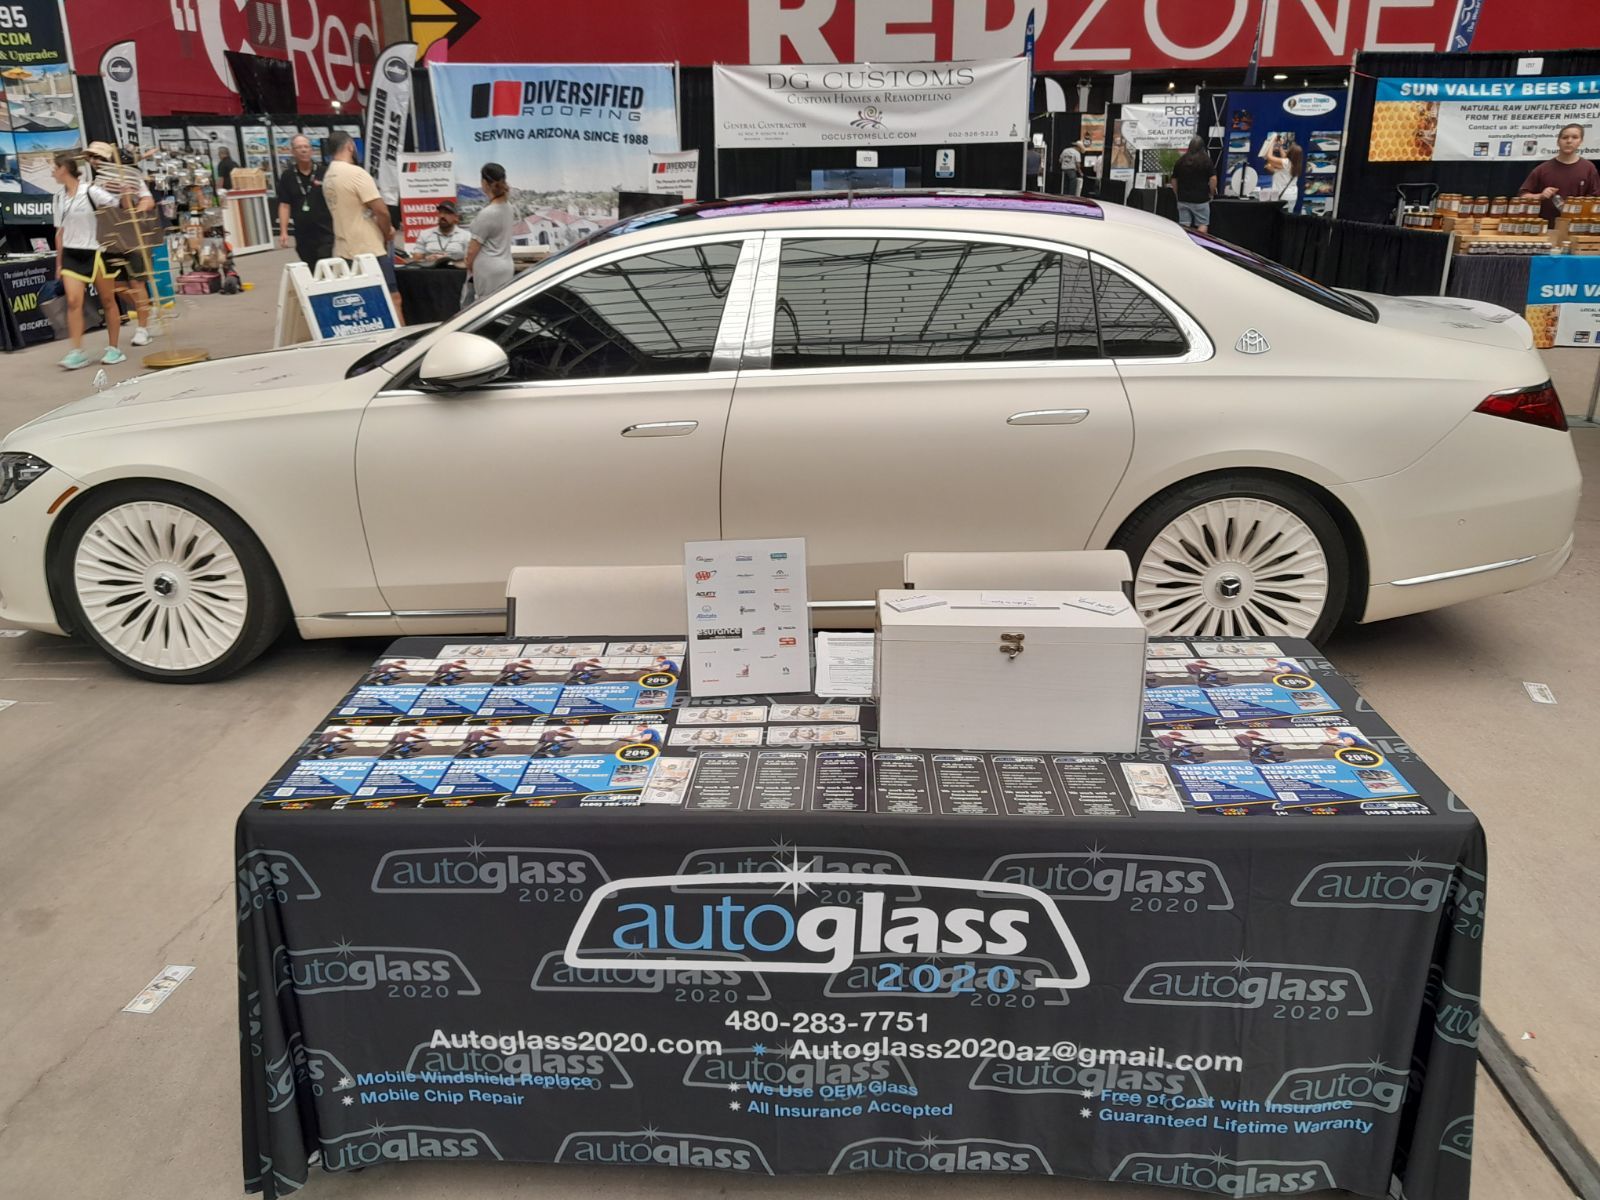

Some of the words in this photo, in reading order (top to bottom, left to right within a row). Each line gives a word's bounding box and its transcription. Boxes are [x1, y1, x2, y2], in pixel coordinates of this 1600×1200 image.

[9, 49, 58, 62] Upgrades
[766, 72, 810, 90] DG
[822, 67, 975, 90] CUSTOMS
[523, 80, 644, 110] DIVERSIFIED
[1400, 82, 1439, 96] SUN
[1445, 83, 1516, 96] VALLEY
[1521, 82, 1572, 96] BEES
[787, 93, 832, 105] CUSTOM
[833, 93, 874, 104] HOMES
[875, 95, 881, 103] &
[884, 91, 952, 103] REMODELING
[521, 105, 642, 122] ROOFING
[1524, 103, 1577, 111] UNFILTERED
[125, 109, 139, 147] STE
[369, 87, 388, 180] BUILDINGS
[723, 121, 757, 130] GENERAL
[757, 120, 807, 129] CONTRACTOR
[385, 111, 402, 162] STEEL
[474, 128, 525, 143] SERVING
[527, 127, 580, 141] ARIZONA
[583, 130, 620, 143] SINCE
[623, 134, 649, 146] 1988
[13, 202, 54, 215] INSUR
[403, 204, 438, 214] IMMED
[405, 217, 439, 226] ESTIMA
[12, 275, 46, 288] PERFECTED
[1540, 284, 1578, 297] SUN
[1282, 678, 1306, 686] 20%
[1345, 754, 1374, 762] 20%
[393, 855, 587, 893] autoglass
[1002, 862, 1207, 901] autoglass
[519, 888, 584, 903] 2020
[1129, 898, 1198, 913] 2020
[612, 892, 1030, 972] autoglass
[877, 963, 1016, 994] 2020
[388, 985, 449, 998] 2020
[675, 988, 738, 1003] 2020
[1148, 971, 1349, 1008] autoglass
[970, 993, 1036, 1008] 2020
[1273, 1004, 1340, 1020] 2020
[725, 1011, 929, 1033] 480-283-7751
[429, 1029, 722, 1056] Autoglass2020.com
[790, 1036, 1243, 1072] Autoglass2020az@gmail.com
[357, 1071, 416, 1087] Mobile
[421, 1071, 515, 1087] Windshield
[520, 1073, 593, 1089] Replace
[360, 1089, 420, 1105] Mobile
[424, 1090, 464, 1105] Chip
[469, 1090, 524, 1105] Repair
[746, 1081, 773, 1096] We
[779, 1084, 813, 1098] Use
[819, 1084, 863, 1098] OEM
[868, 1081, 918, 1097] Glass
[747, 1100, 769, 1115] All
[775, 1103, 862, 1118] Insurance
[867, 1101, 953, 1119] Accepted
[1101, 1089, 1142, 1105] Free
[1147, 1092, 1168, 1107] of
[1171, 1094, 1215, 1110] Cost
[1220, 1097, 1260, 1113] with
[1265, 1098, 1353, 1114] Insurance
[1099, 1108, 1207, 1128] Guaranteed
[1213, 1117, 1288, 1134] Lifetime
[1294, 1118, 1373, 1135] Warranty
[323, 1132, 479, 1171] utoglass
[575, 1140, 751, 1170] autoglass
[849, 1145, 1030, 1174] autoglass
[1132, 1159, 1317, 1198] autoglass
